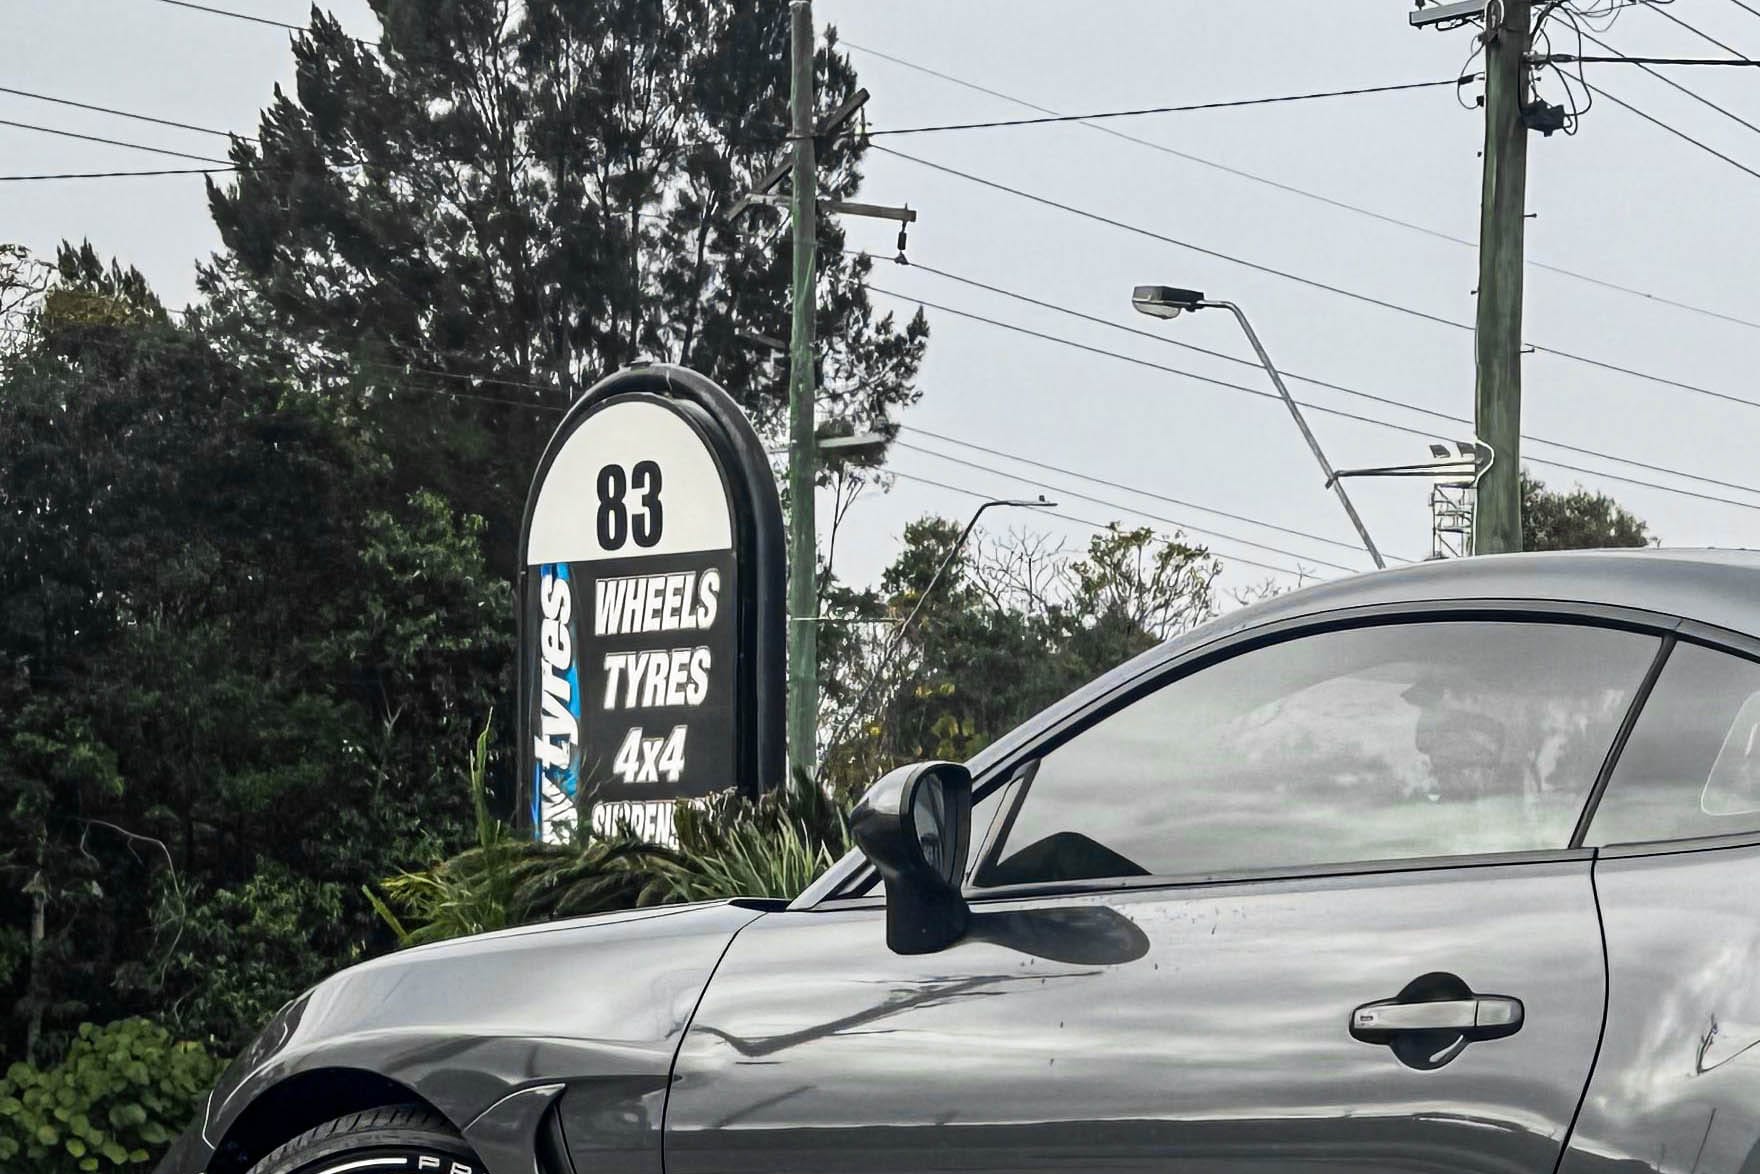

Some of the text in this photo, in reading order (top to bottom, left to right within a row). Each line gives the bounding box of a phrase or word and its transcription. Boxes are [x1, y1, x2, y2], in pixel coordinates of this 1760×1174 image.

[597, 460, 663, 551] 83
[594, 567, 720, 637] WHEELS
[603, 645, 712, 711] TYRES
[612, 723, 688, 784] 4x4
